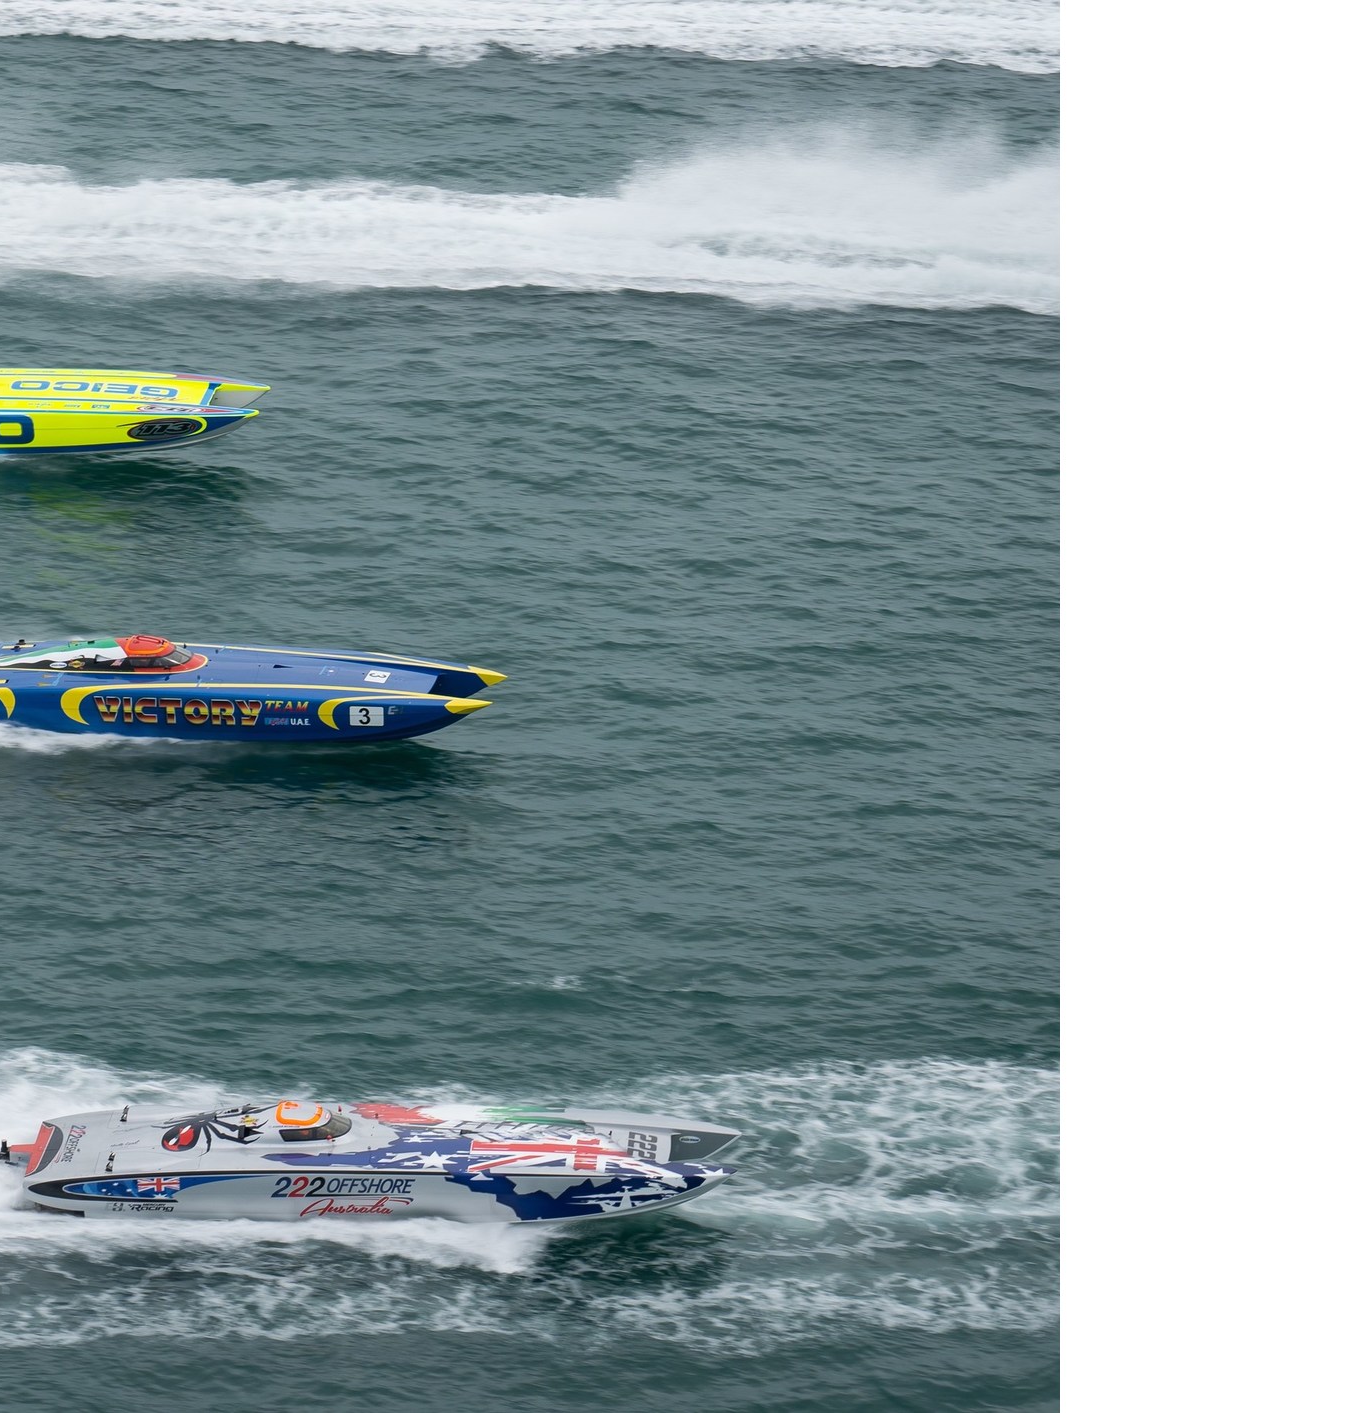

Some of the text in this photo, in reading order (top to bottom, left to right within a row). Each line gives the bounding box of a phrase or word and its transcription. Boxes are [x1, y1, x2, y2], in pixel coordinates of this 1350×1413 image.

[11, 381, 178, 397] GEICO
[93, 696, 309, 726] VICTORY TEAM
[358, 708, 370, 725] 3
[626, 1131, 658, 1160] 222
[271, 1176, 416, 1198] 222 OFFSHORE
[130, 1203, 174, 1212] Racing
[300, 1196, 393, 1217] Australia
